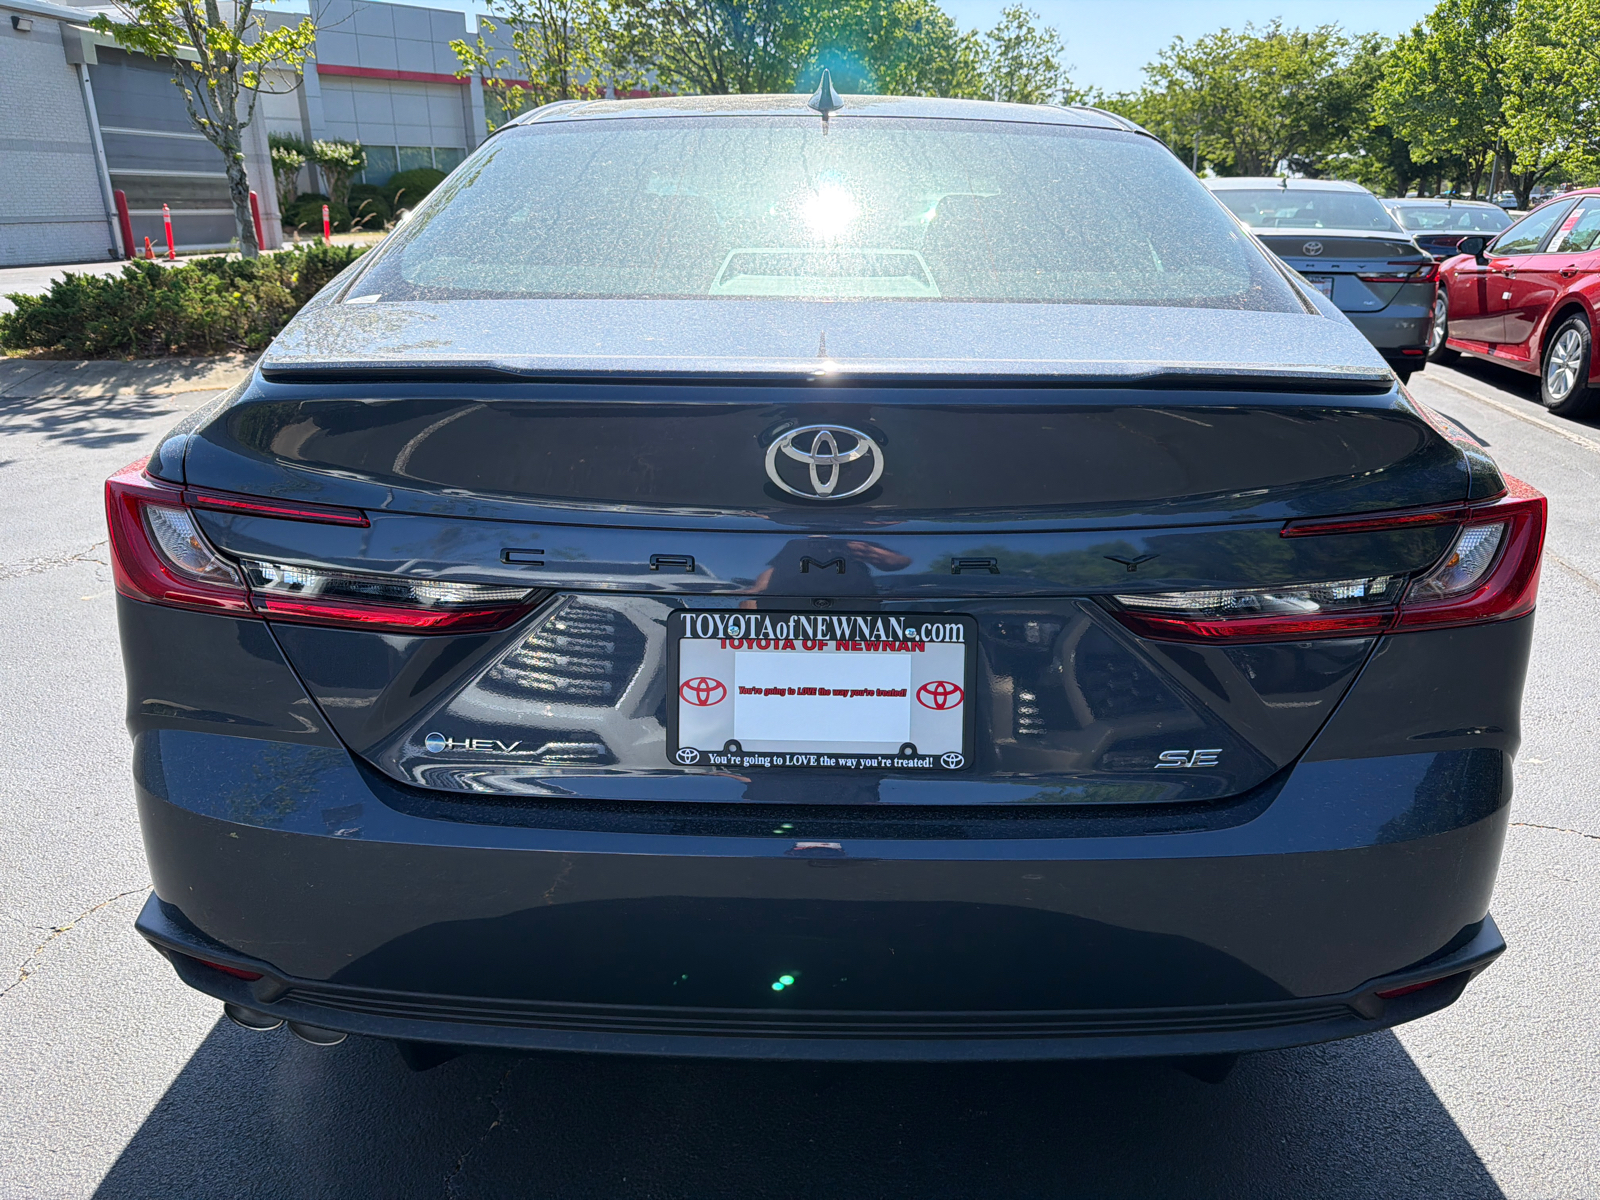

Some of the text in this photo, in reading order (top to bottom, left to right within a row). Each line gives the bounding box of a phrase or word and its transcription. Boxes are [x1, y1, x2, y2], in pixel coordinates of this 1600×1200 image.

[500, 547, 1160, 575] CAMRY
[720, 638, 925, 652] TOYOTA OF NEWNAN
[763, 686, 786, 697] going
[787, 687, 796, 695] to
[797, 687, 817, 696] LOVE
[818, 687, 831, 696] the
[832, 689, 849, 698] way
[876, 688, 907, 697] treated!
[448, 737, 523, 753] HEV
[743, 754, 771, 767] going
[773, 756, 784, 765] to
[785, 754, 818, 766] LOVE
[820, 755, 836, 766] the
[838, 758, 858, 769] way
[894, 757, 934, 768] treated!
[1154, 748, 1223, 769] SE
